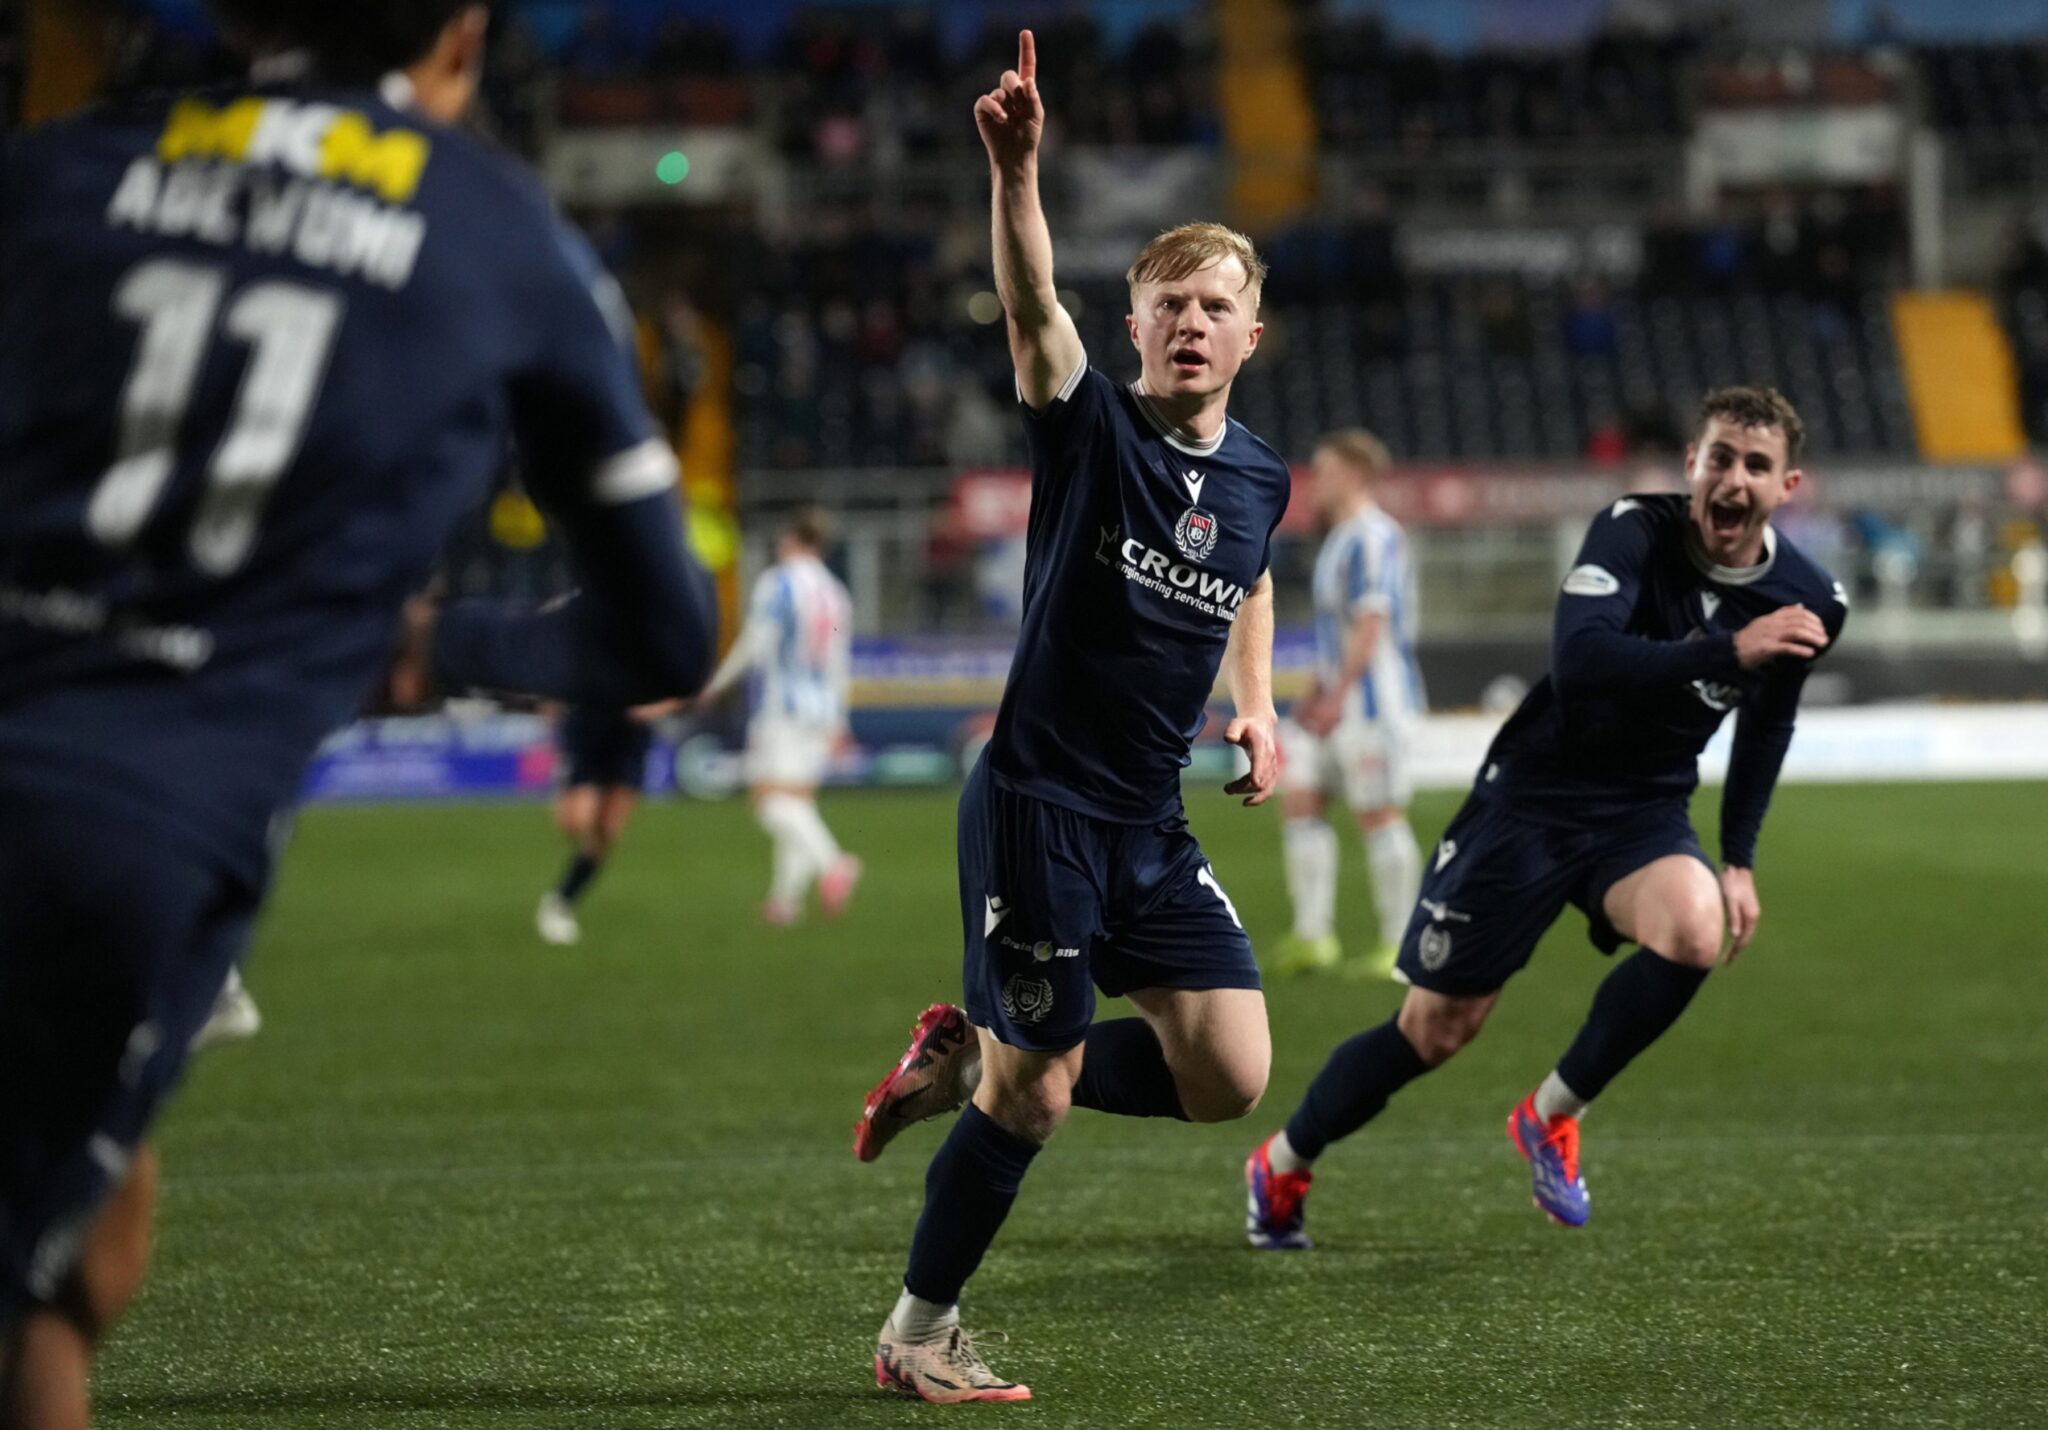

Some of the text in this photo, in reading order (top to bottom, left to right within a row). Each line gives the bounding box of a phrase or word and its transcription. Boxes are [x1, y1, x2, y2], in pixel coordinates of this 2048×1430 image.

[156, 95, 431, 203] MKM
[84, 257, 343, 577] 11
[1115, 561, 1173, 599] engineering
[1174, 589, 1215, 614] services
[1121, 538, 1249, 608] CROWN
